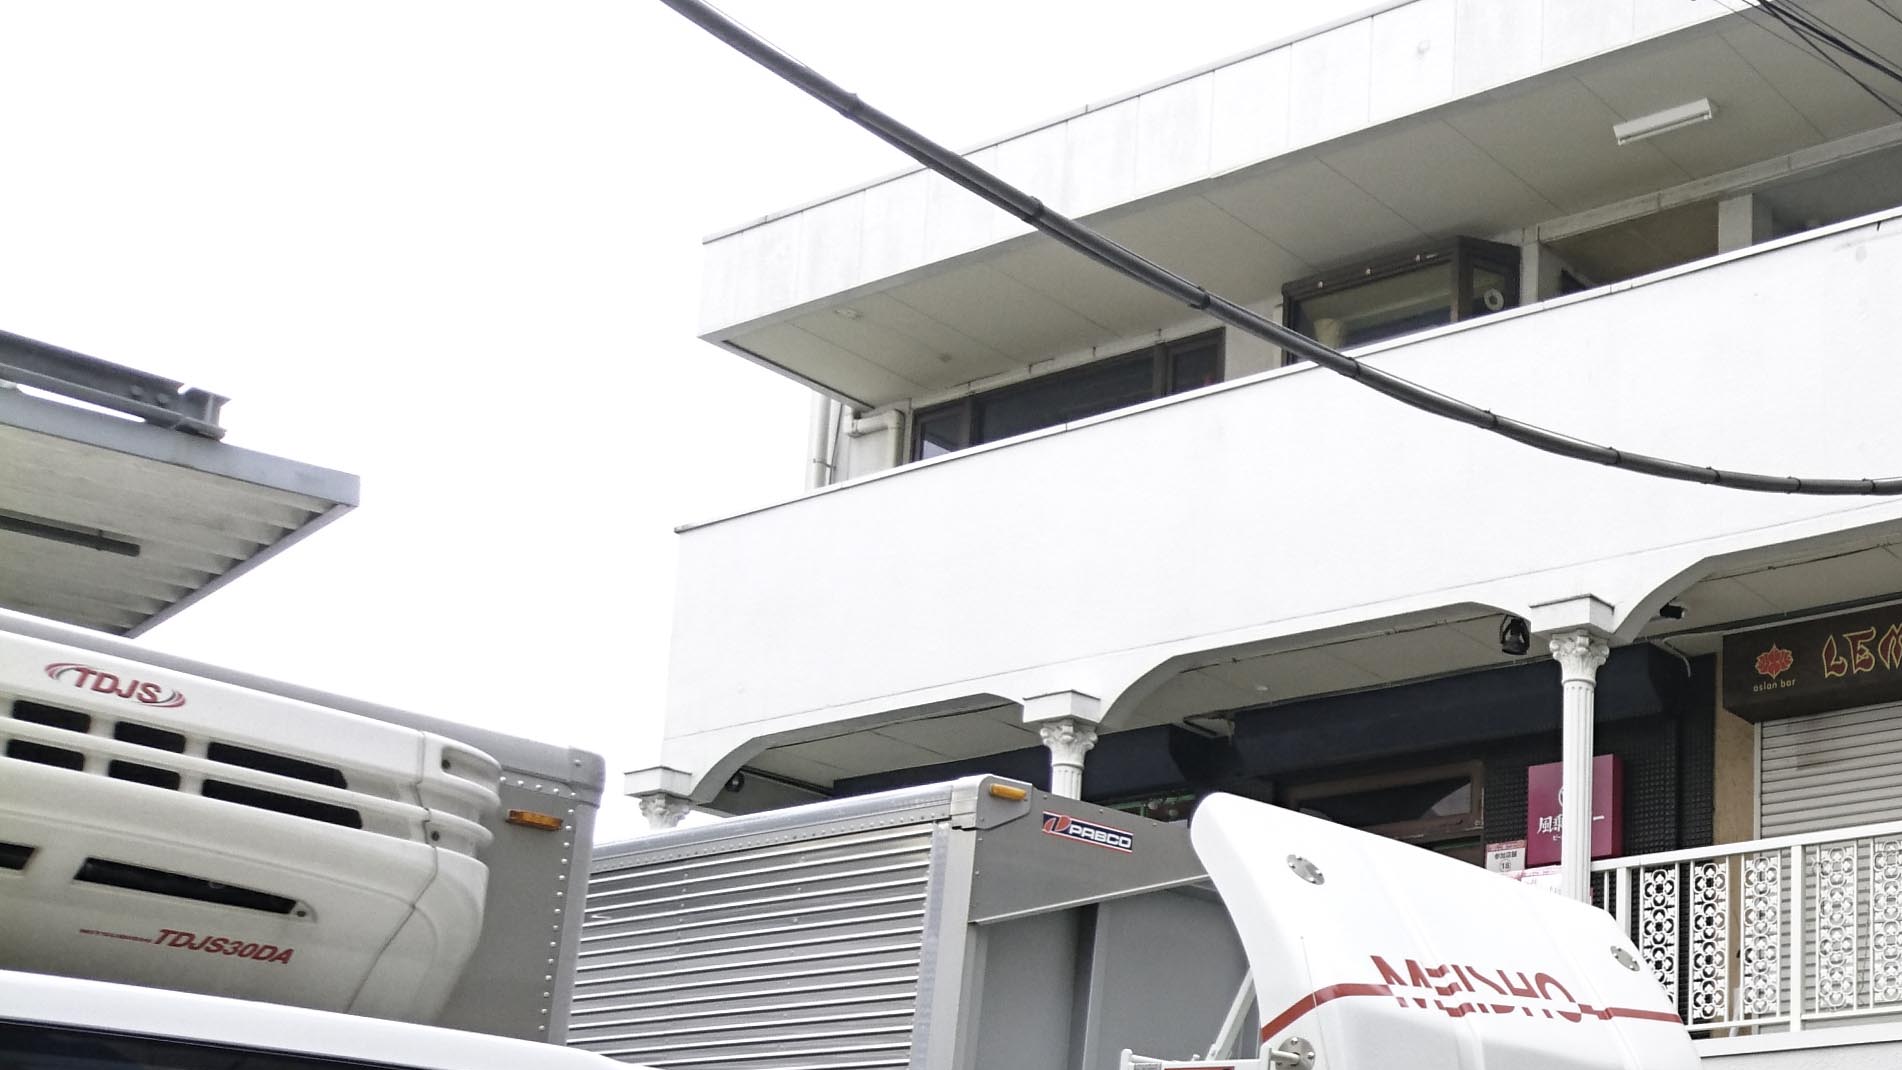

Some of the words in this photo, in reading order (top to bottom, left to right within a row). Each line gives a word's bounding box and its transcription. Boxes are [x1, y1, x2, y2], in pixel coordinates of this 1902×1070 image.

[74, 667, 162, 704] TDJS
[1780, 678, 1796, 688] bar
[1069, 824, 1132, 848] PABCO
[152, 929, 295, 964] TDJS30DA
[1371, 955, 1582, 1023] MEISHO
